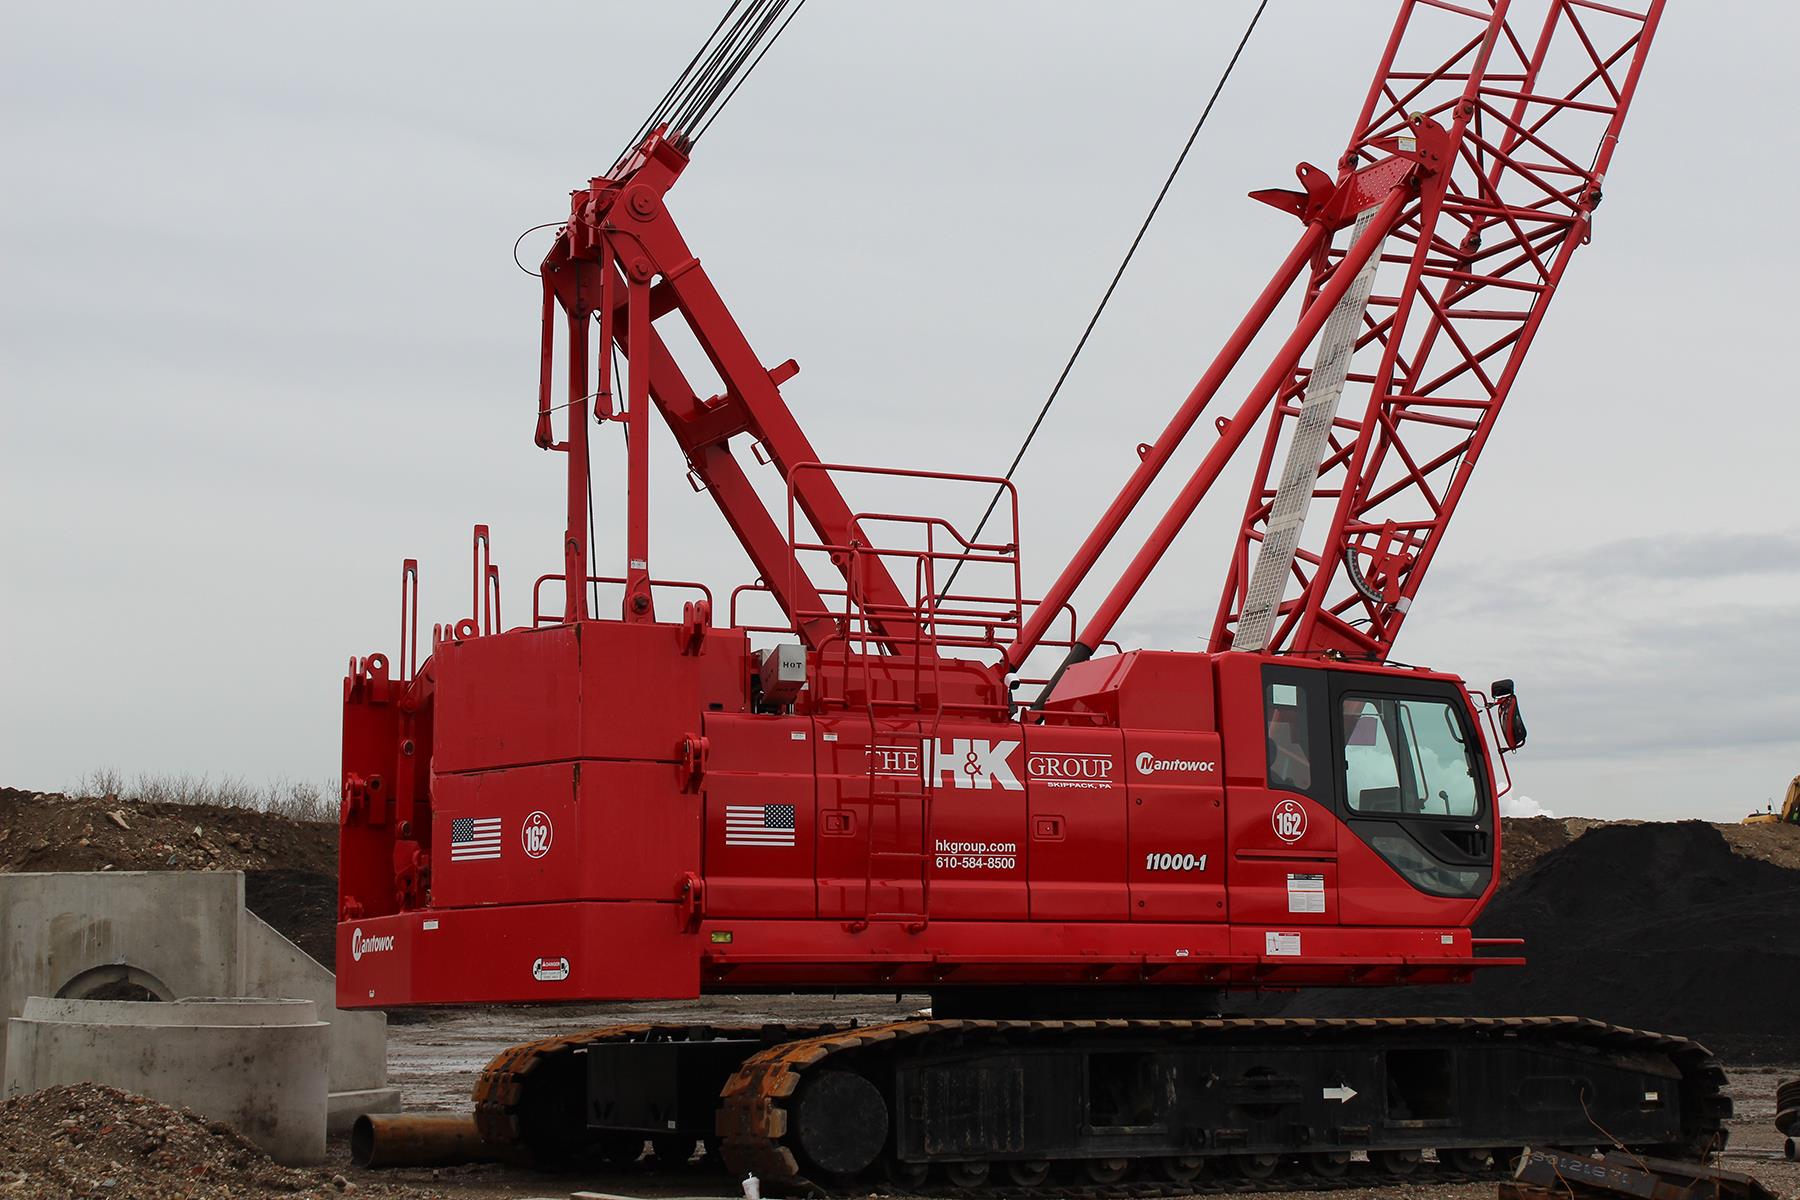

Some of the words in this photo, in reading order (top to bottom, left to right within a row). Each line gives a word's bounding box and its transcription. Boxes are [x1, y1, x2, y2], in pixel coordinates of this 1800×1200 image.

[783, 661, 802, 669] HOT
[923, 738, 1024, 790] H&K
[1027, 757, 1113, 778] GROUP
[1135, 752, 1215, 775] Manitowoc
[1284, 802, 1294, 812] C
[533, 814, 541, 825] C
[1276, 812, 1302, 836] 162
[525, 825, 548, 852] 162
[935, 839, 1016, 854] hkgroup.com
[936, 856, 1016, 869] 610-584-8500
[1146, 853, 1207, 871] 11000-1
[352, 927, 395, 962] Manitowoc
